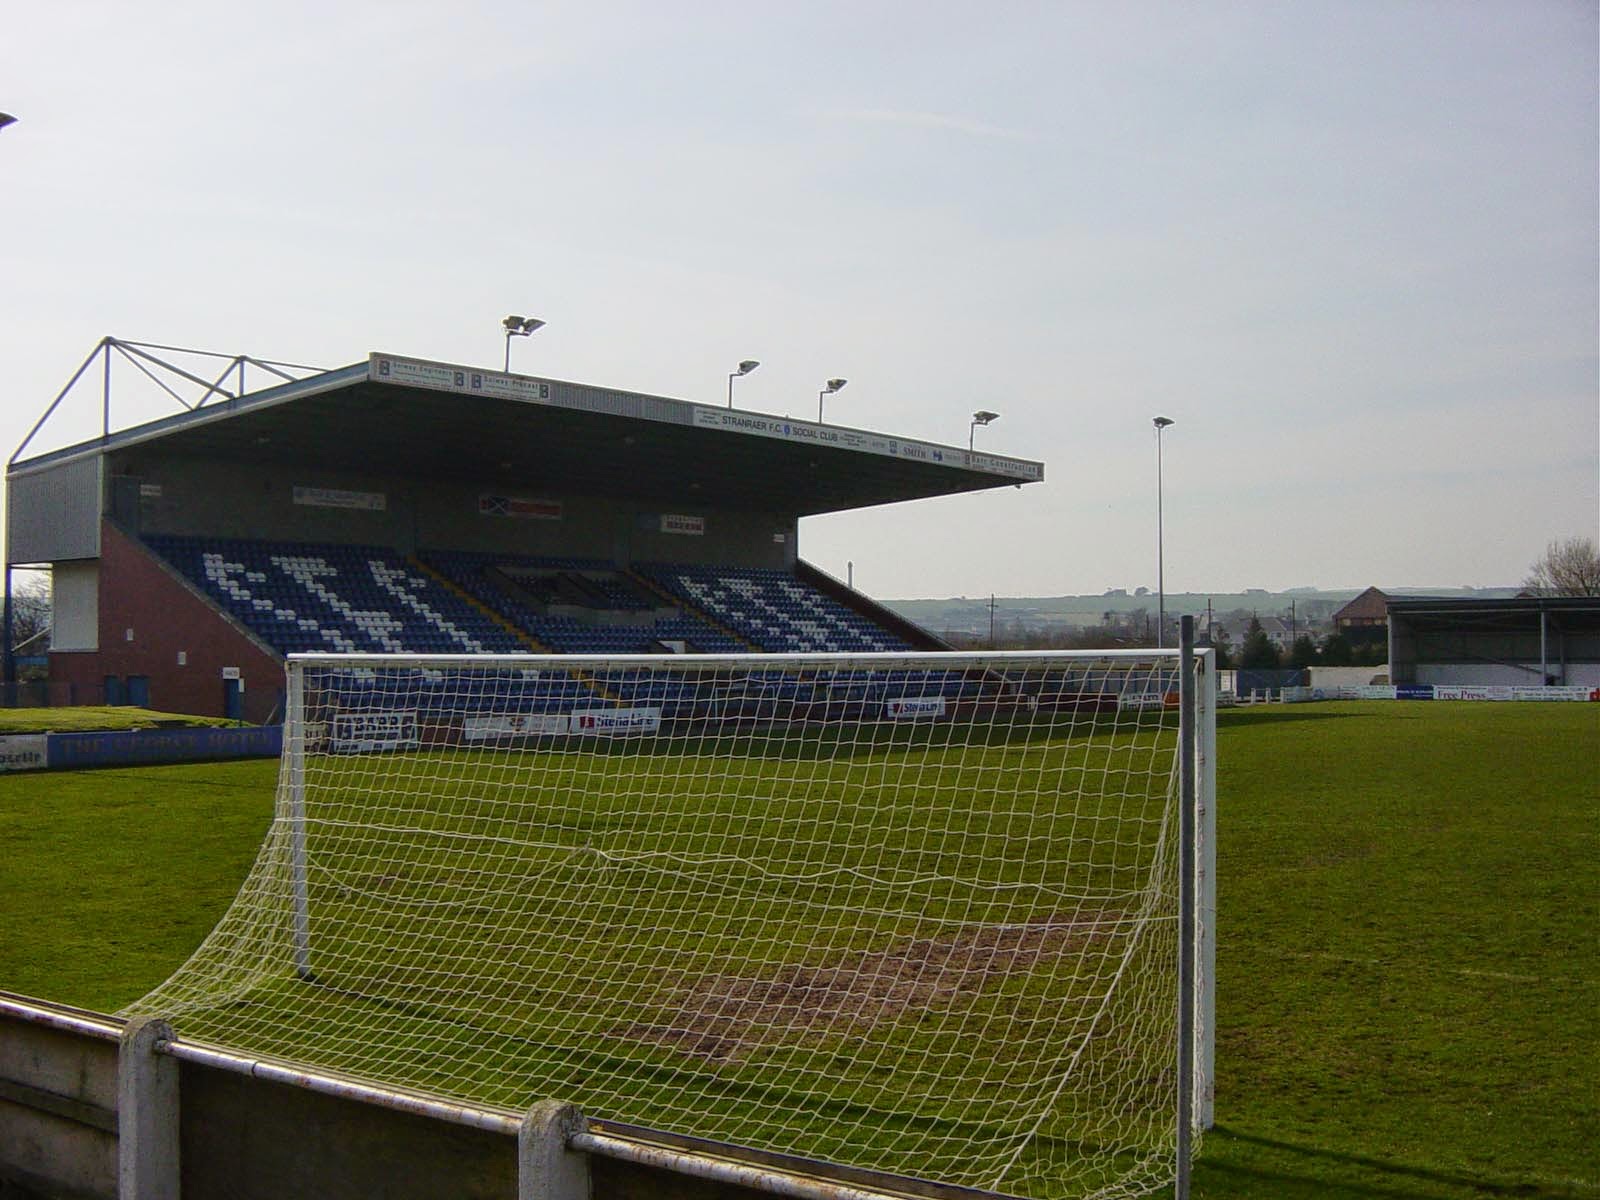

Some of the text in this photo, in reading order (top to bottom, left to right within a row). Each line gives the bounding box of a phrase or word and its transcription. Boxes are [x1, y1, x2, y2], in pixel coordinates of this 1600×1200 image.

[722, 415, 767, 431] STRANRAER
[792, 426, 818, 439] SOCIAL
[819, 431, 839, 442] CLUB
[1460, 690, 1487, 700] Press
[354, 716, 399, 732] BARR
